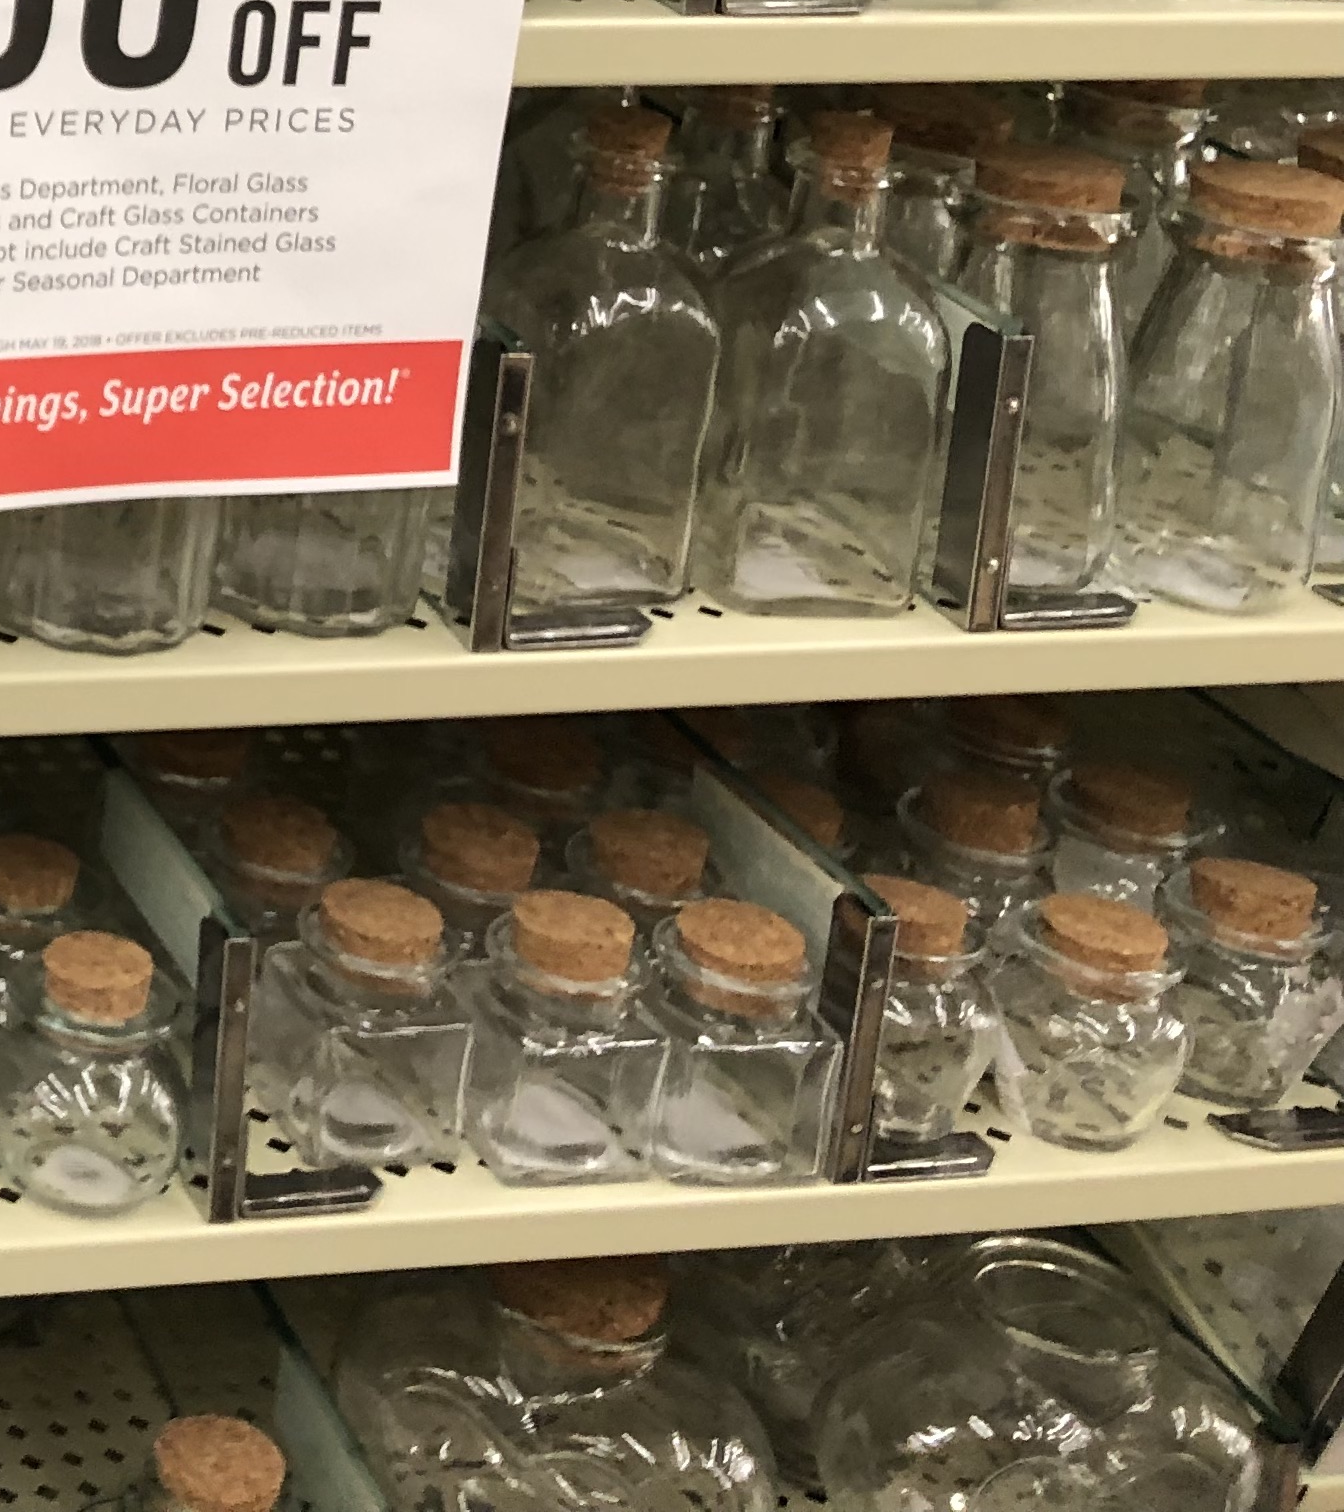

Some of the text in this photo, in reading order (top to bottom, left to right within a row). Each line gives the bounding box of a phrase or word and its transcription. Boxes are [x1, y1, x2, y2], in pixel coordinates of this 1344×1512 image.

[10, 108, 206, 138] EVERYDAY
[224, 107, 357, 134] PRICES
[19, 175, 165, 203] Department,
[173, 173, 239, 195] Floral
[246, 171, 309, 194] Glass
[8, 210, 53, 232] and
[59, 207, 116, 231] Craft
[123, 203, 185, 227] Glass
[192, 201, 320, 226] Containers
[24, 238, 108, 261] include
[114, 234, 171, 257] Craft
[179, 232, 268, 255] Stained
[275, 231, 337, 253] Glass
[12, 269, 114, 294] Seasonal
[121, 263, 262, 290] Department
[19, 336, 49, 351] MAY
[115, 327, 163, 345] OFFER
[165, 325, 237, 343] EXCLUDES
[240, 323, 339, 339] PRE-REDUCED
[342, 322, 384, 337] ITEMS
[98, 378, 211, 426] Super
[216, 366, 402, 413] Selection!
